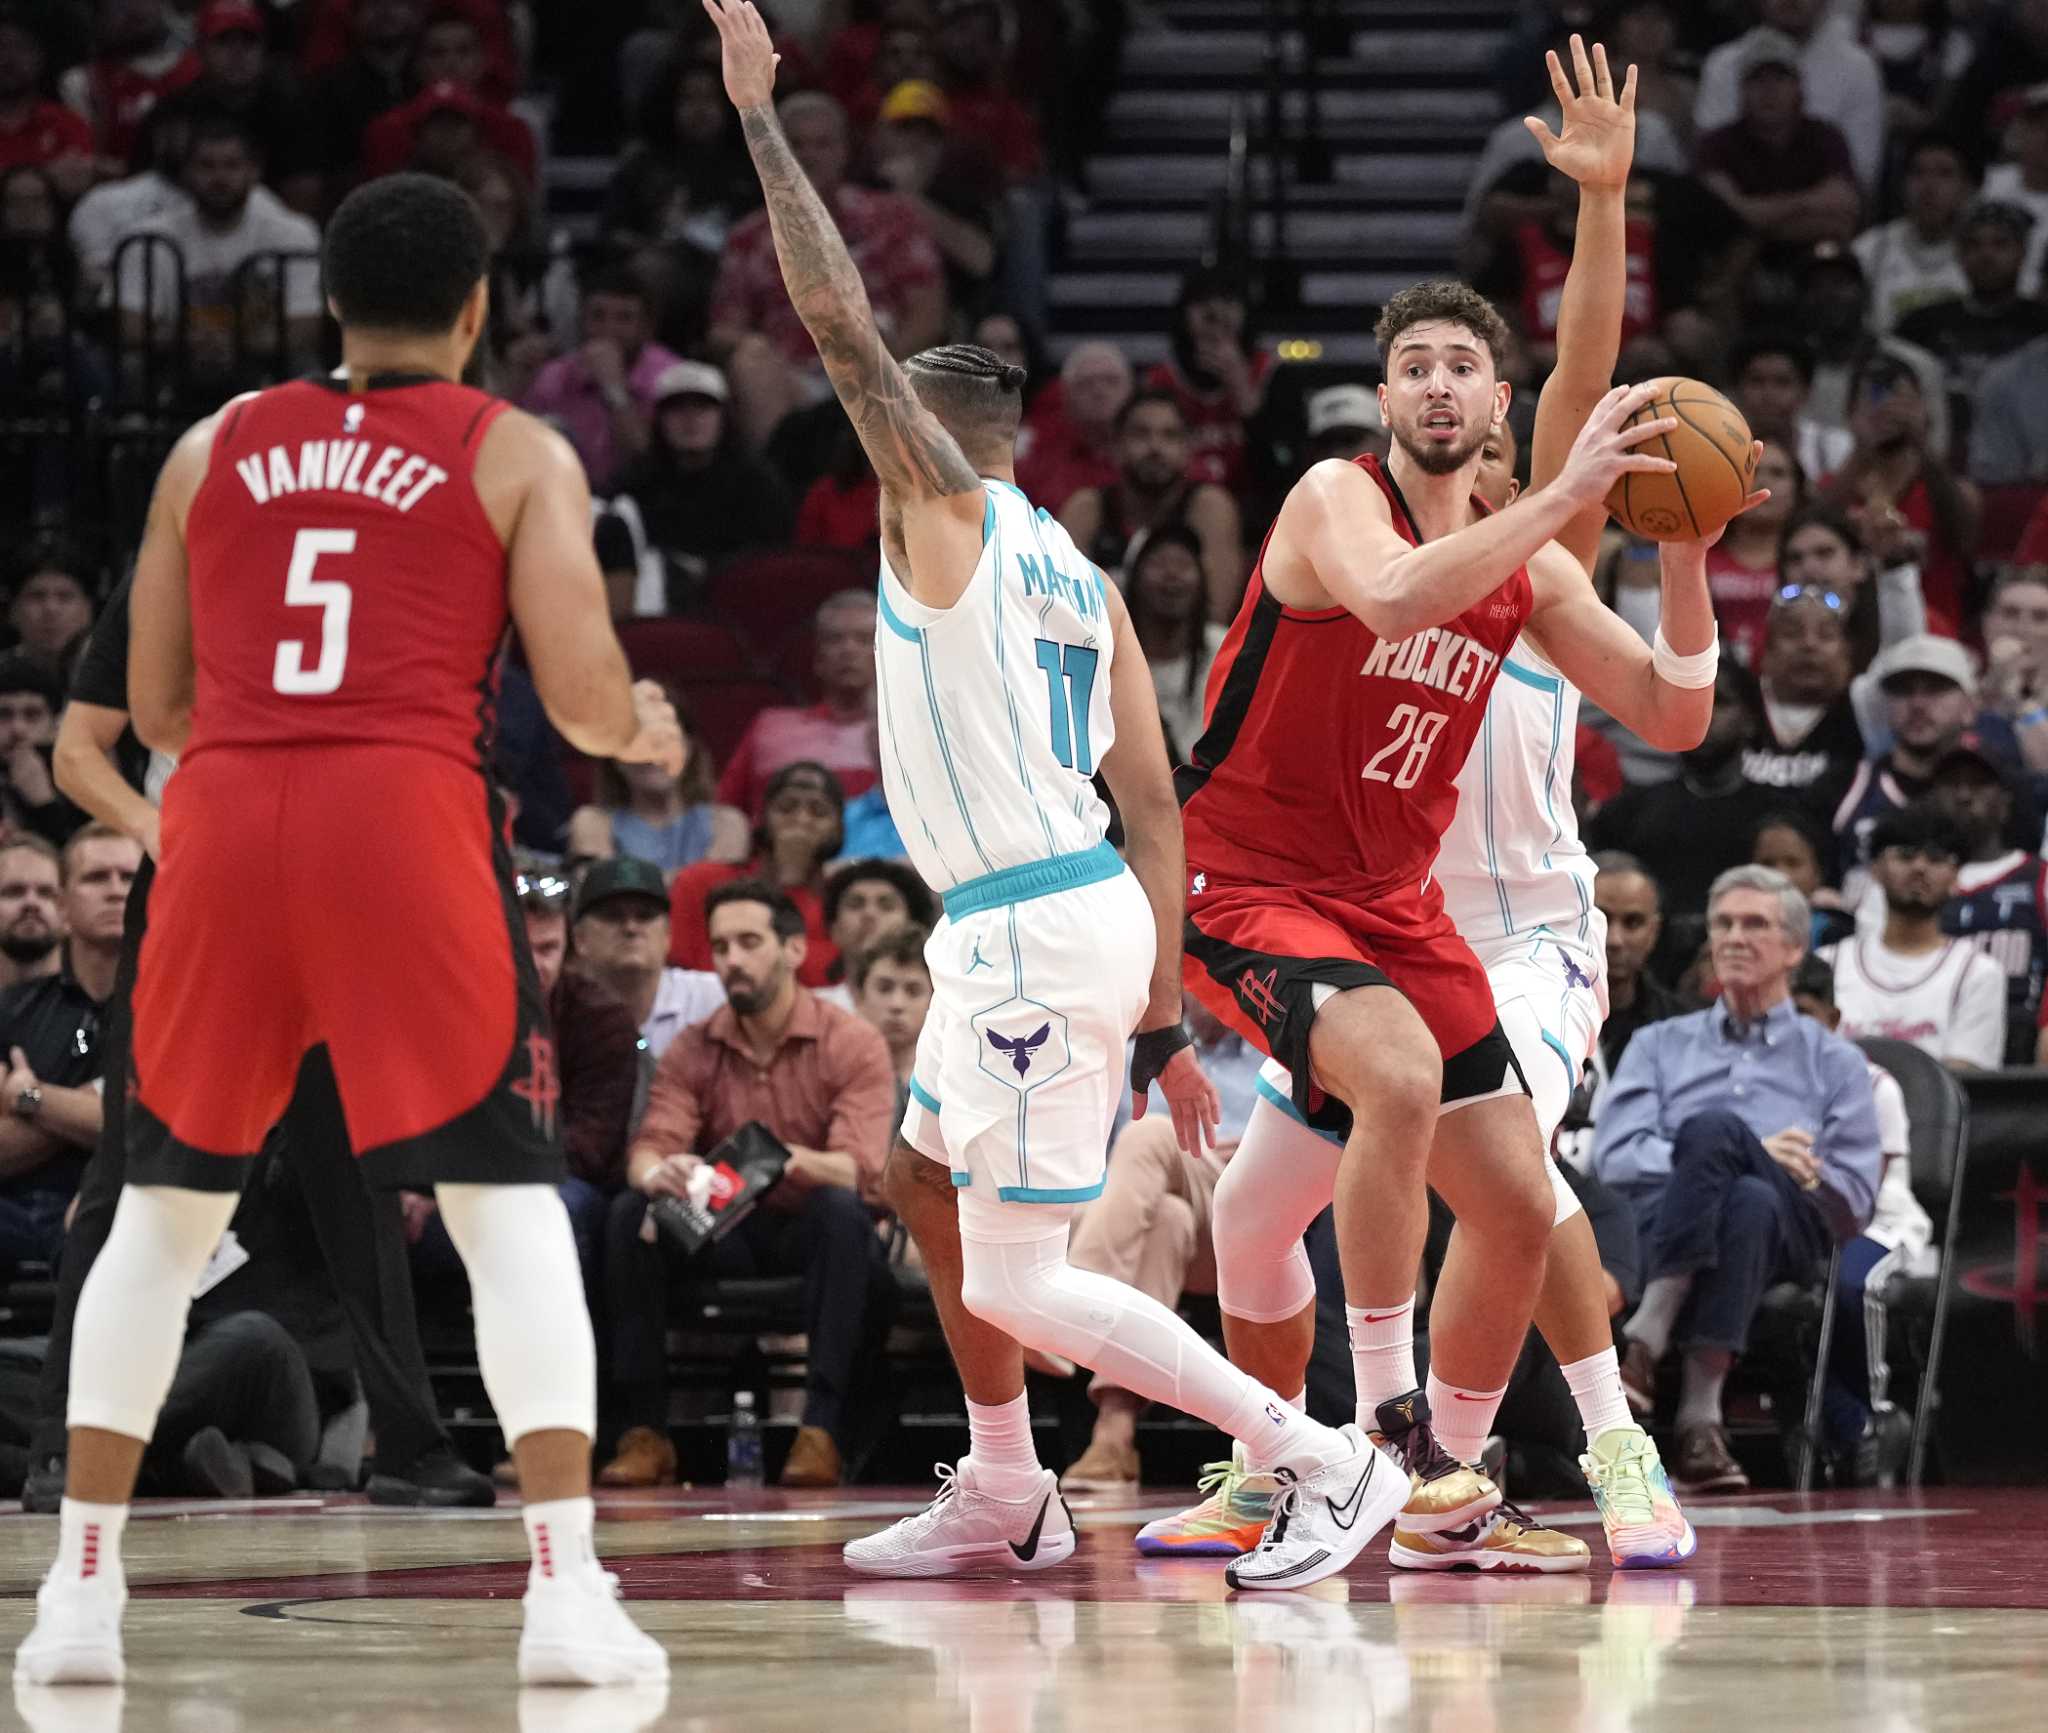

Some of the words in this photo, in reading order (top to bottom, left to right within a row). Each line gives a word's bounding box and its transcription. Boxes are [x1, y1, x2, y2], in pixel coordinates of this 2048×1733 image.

[236, 439, 449, 512] VANVLEET
[273, 531, 357, 695] 5
[1034, 638, 1099, 776] 11
[1360, 627, 1500, 704] ROCKET
[1361, 703, 1450, 789] 28
